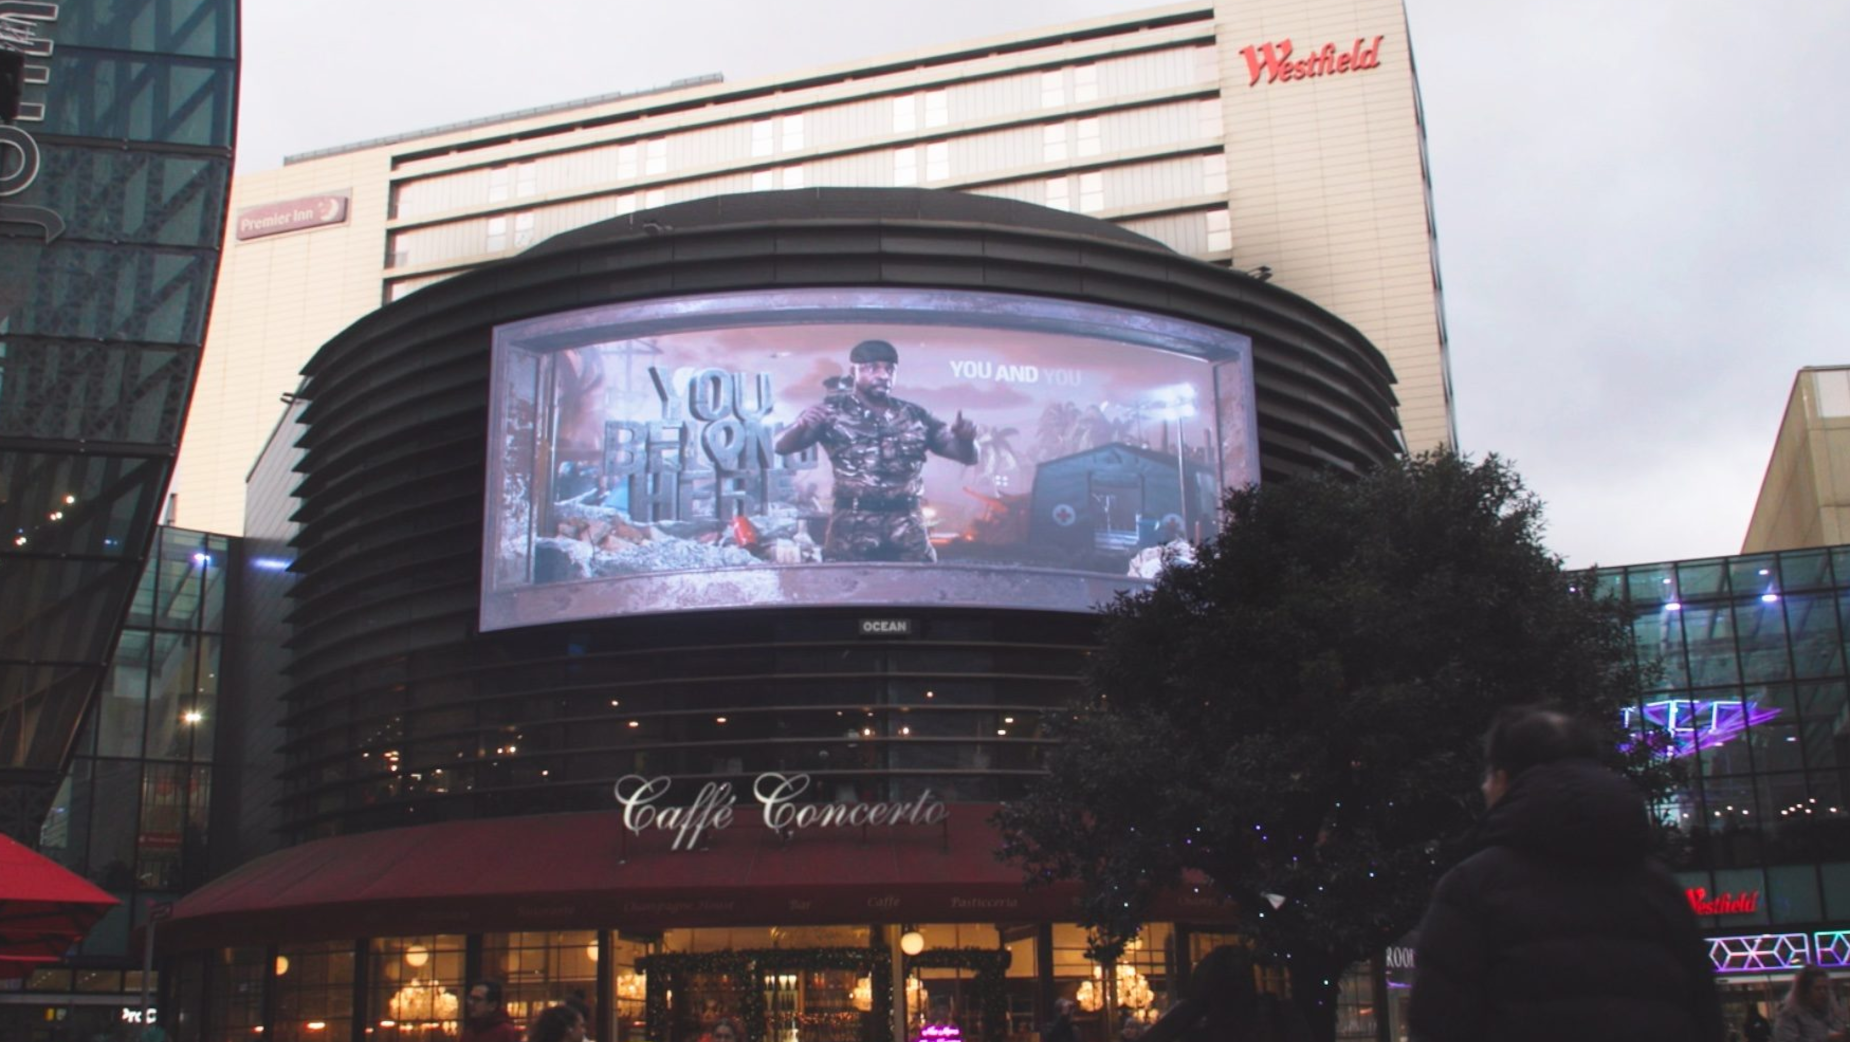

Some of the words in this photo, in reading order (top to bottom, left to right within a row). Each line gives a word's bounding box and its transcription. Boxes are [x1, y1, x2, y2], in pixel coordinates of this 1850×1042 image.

[1239, 35, 1384, 87] Westfield
[241, 213, 291, 231] Premier
[293, 209, 314, 221] Inn
[949, 360, 992, 379] YOU
[994, 364, 1039, 383] AND
[1043, 368, 1082, 386] YOU
[648, 366, 774, 423] YOU
[862, 621, 907, 632] OCEAN
[754, 772, 948, 834] Concerto
